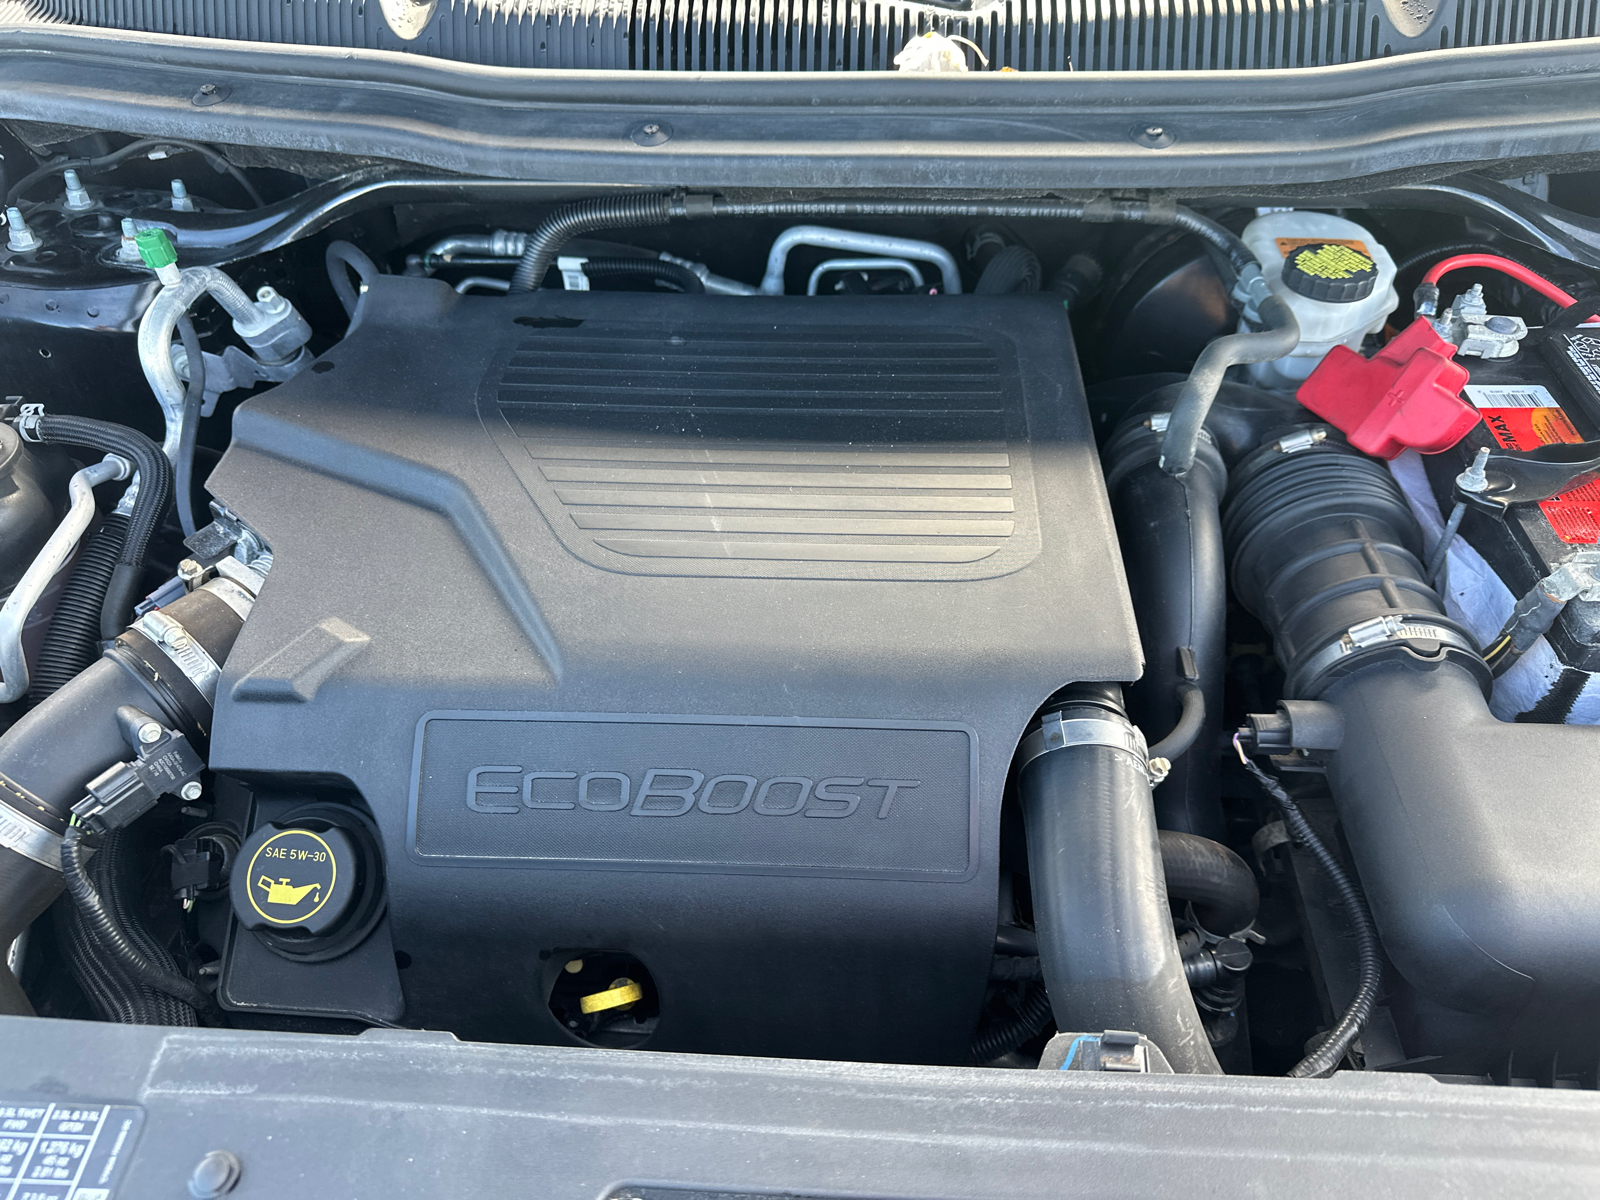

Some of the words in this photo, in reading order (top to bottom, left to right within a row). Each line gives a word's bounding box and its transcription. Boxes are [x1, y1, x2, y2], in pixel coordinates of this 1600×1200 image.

[1488, 415, 1516, 443] MAX
[265, 846, 287, 860] SAE
[290, 848, 327, 863] 5W-30
